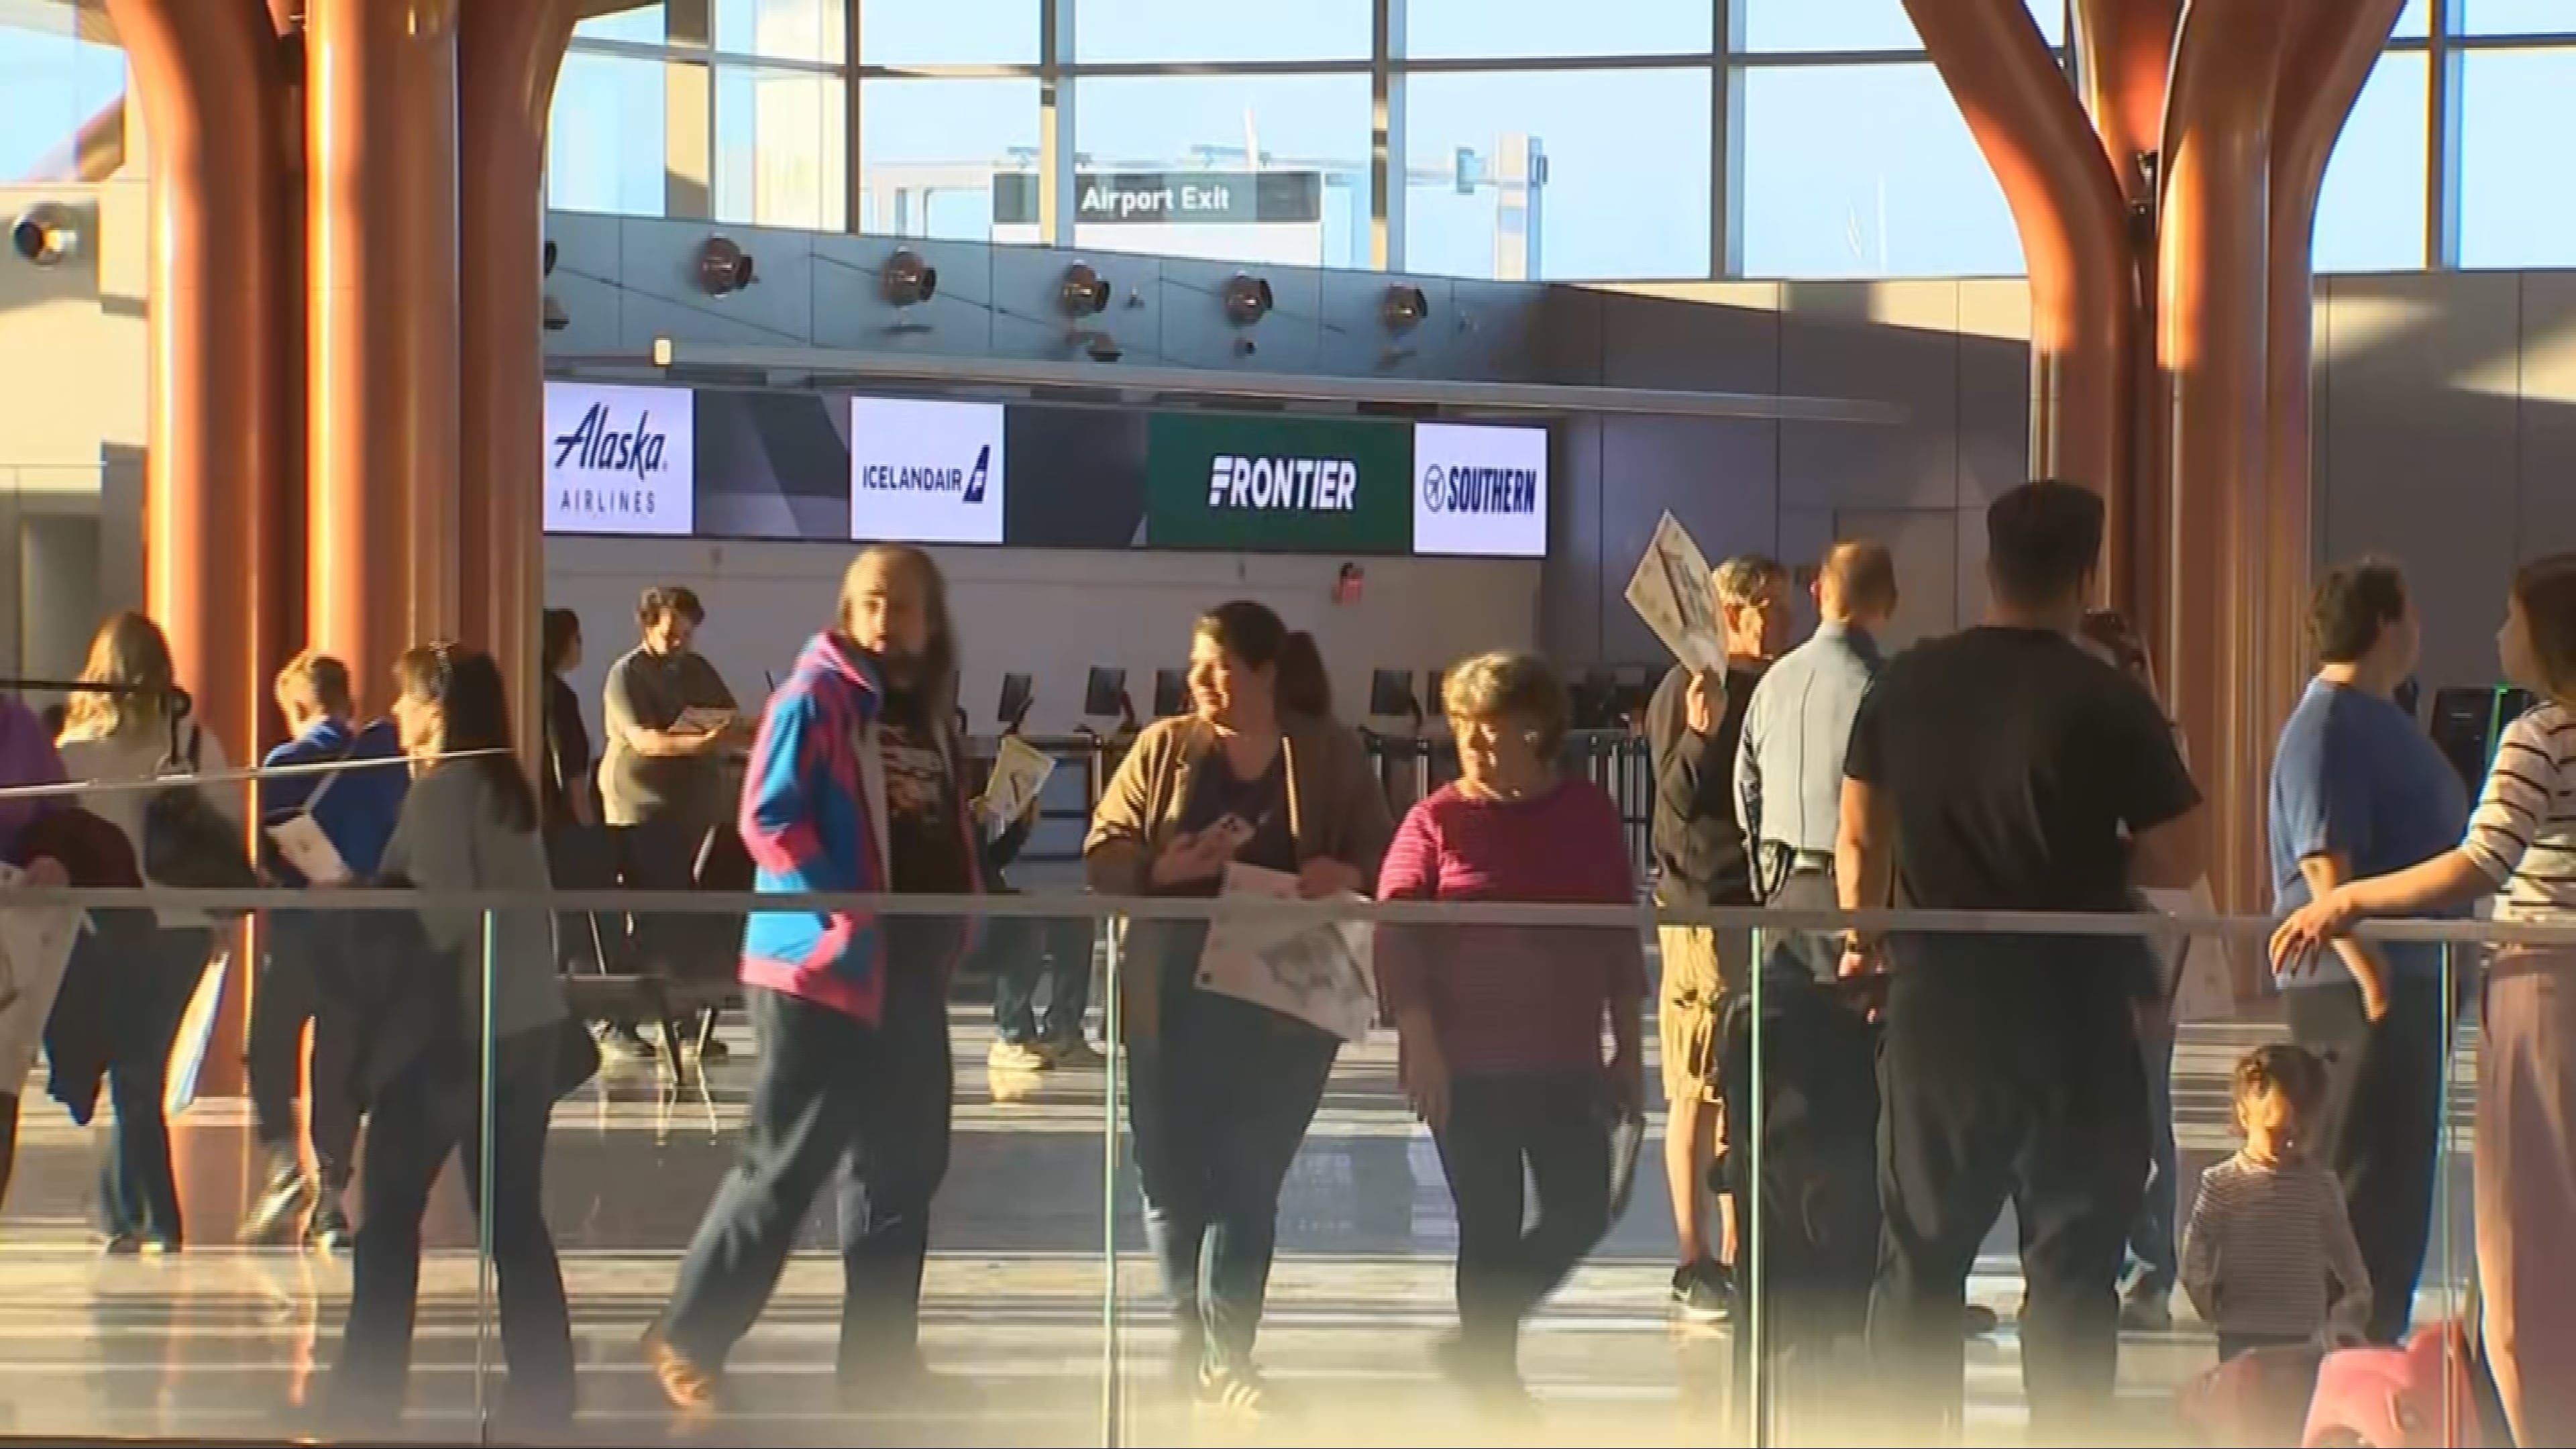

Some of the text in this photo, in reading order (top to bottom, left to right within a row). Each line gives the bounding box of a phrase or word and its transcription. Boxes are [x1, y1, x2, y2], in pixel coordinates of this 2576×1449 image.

[1081, 184, 1230, 217] Airport Exit
[554, 402, 665, 480] Alaska
[863, 466, 962, 492] ICELANDAIR
[1210, 455, 1356, 510] FRONTIER
[1448, 466, 1538, 513] SOUTHERN
[561, 490, 655, 515] AIRLINES
